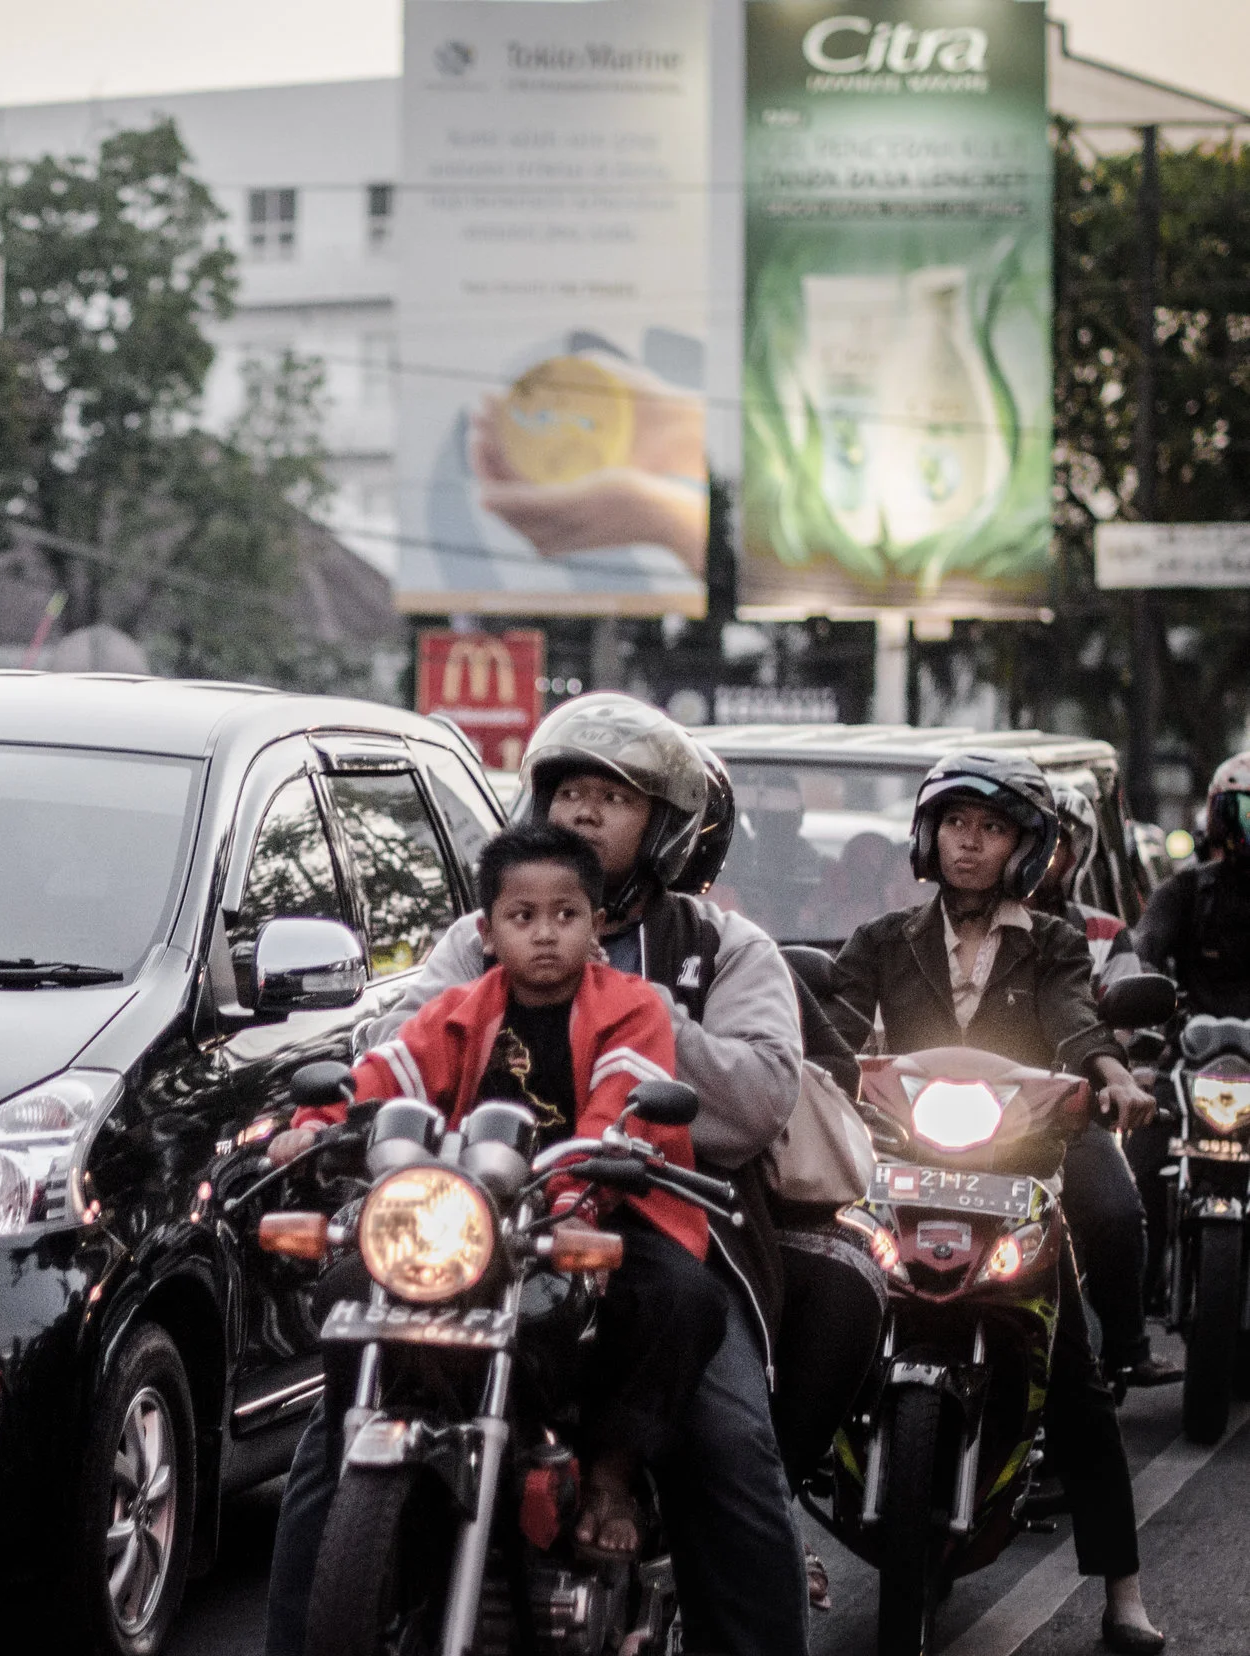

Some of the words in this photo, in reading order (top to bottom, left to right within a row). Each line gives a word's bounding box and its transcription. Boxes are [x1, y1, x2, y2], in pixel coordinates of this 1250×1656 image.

[802, 15, 989, 74] Citra
[876, 1167, 890, 1183] H
[920, 1170, 980, 1192] 2112
[1011, 1180, 1027, 1198] F
[332, 1300, 358, 1322] H
[463, 1308, 513, 1329] FY
